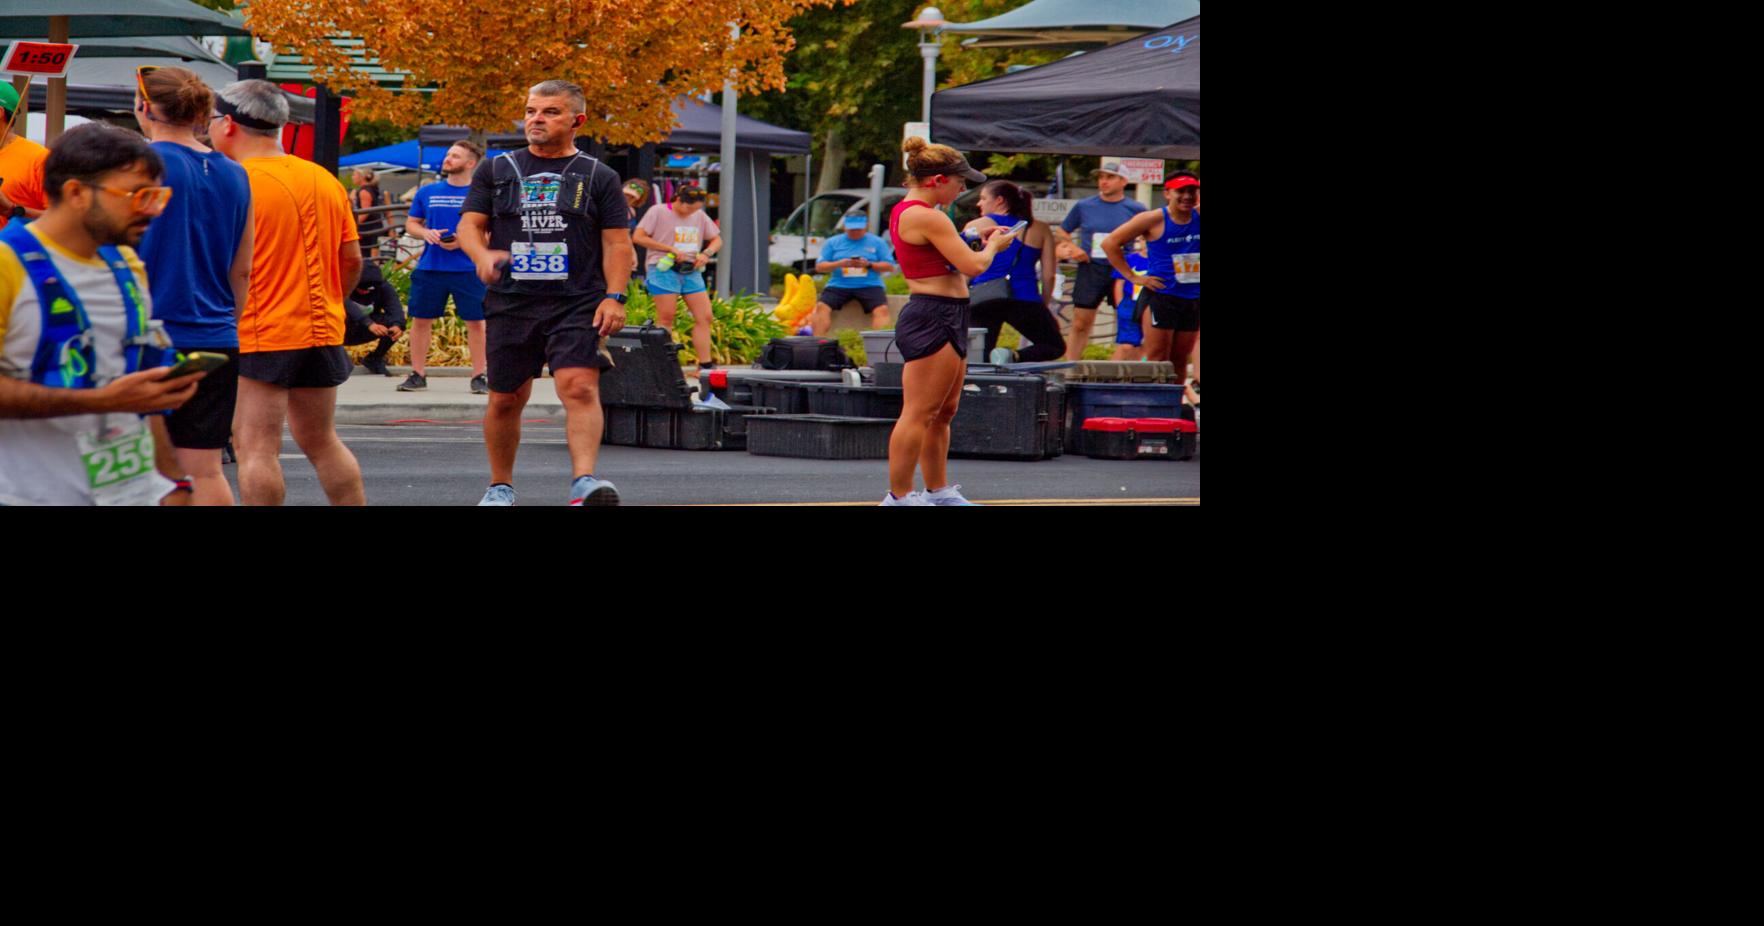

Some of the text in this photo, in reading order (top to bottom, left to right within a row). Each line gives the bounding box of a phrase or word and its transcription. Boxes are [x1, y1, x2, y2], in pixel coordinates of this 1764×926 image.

[19, 51, 65, 65] 1:50
[520, 215, 568, 228] RIVER
[513, 255, 566, 272] 358
